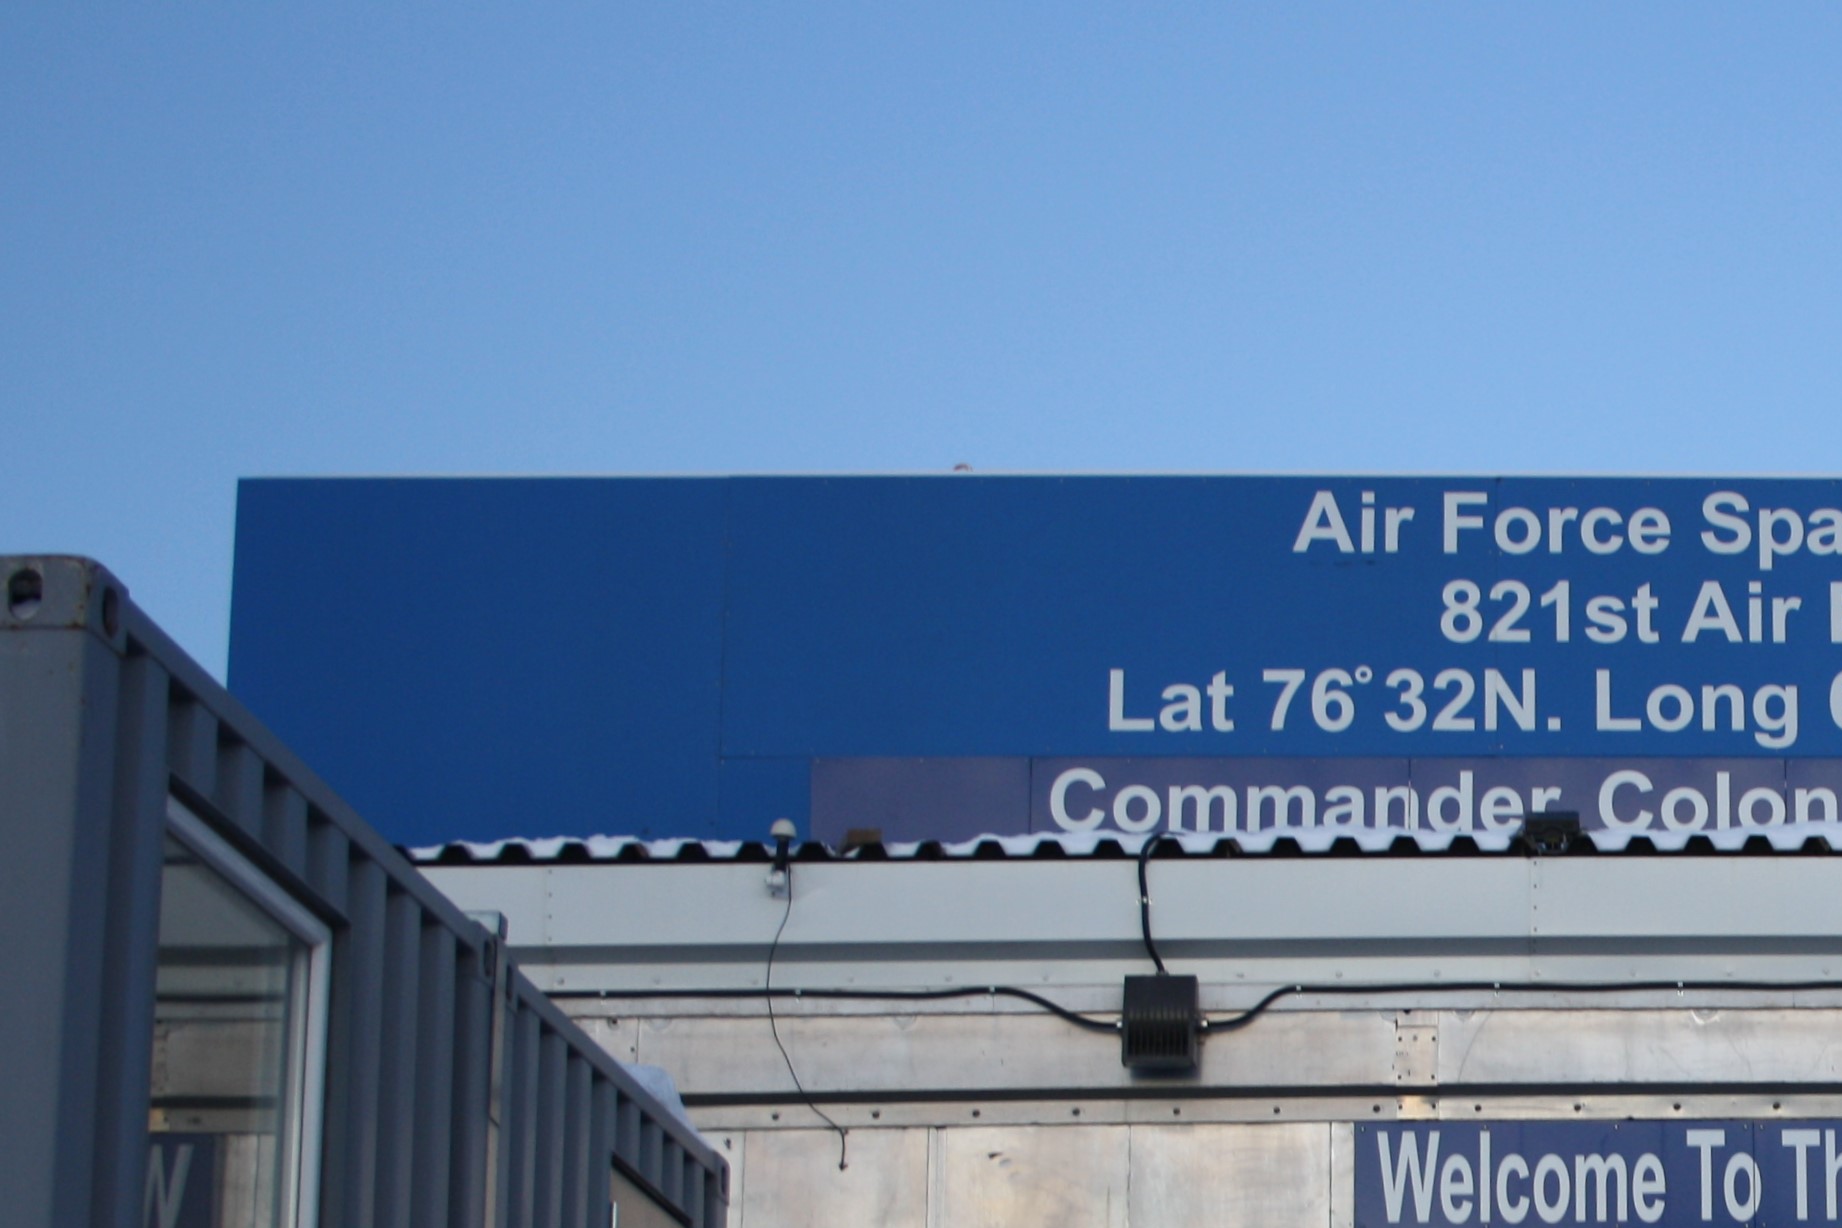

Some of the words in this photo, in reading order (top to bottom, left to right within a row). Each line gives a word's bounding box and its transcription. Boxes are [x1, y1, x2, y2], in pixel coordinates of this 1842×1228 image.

[1294, 492, 1414, 553] Air
[1444, 492, 1670, 554] Force
[1441, 580, 1659, 642] 821st
[1682, 581, 1801, 643] Air
[1109, 669, 1233, 732] Lat
[1597, 669, 1798, 748] Long
[1050, 768, 1561, 832] Commander
[1377, 1130, 1665, 1224] Welcome
[1687, 1129, 1761, 1221] To
